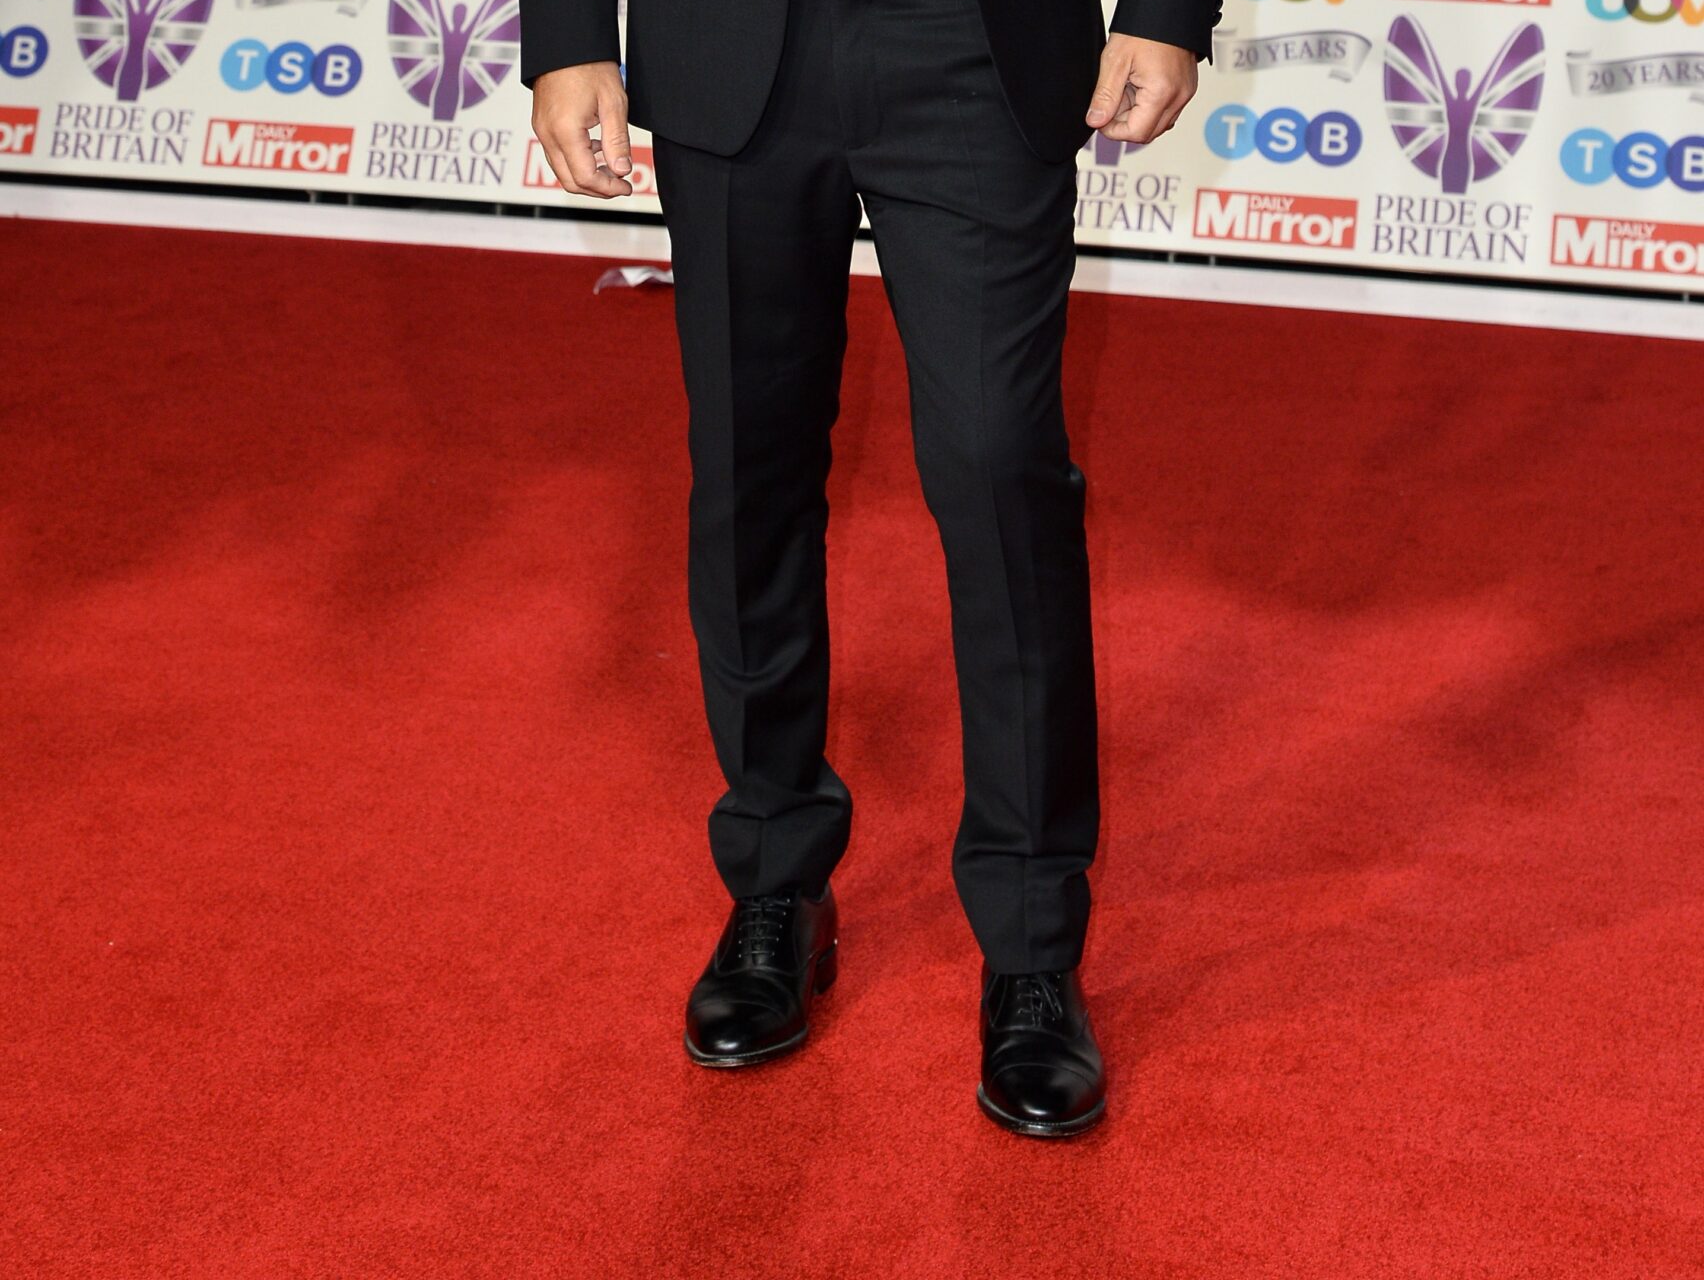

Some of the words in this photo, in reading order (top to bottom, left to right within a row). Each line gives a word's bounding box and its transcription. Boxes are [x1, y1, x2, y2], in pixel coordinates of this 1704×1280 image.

[236, 49, 353, 88] TSB
[1232, 47, 1260, 69] 20
[1265, 39, 1347, 63] YEARS
[1587, 70, 1616, 92] 20
[54, 102, 144, 131] PRIDE
[150, 107, 195, 136] OF
[255, 124, 298, 140] DAILY
[1220, 115, 1350, 157] TSB
[49, 130, 189, 165] BRITAIN
[204, 121, 349, 172] Mirror
[369, 121, 463, 154] PRIDE
[468, 127, 514, 156] OF
[365, 151, 508, 187] BRITAIN
[1135, 172, 1182, 202] OF
[1250, 195, 1294, 211] DAILY
[1195, 191, 1355, 247] Mirror
[1373, 192, 1478, 226] PRIDE
[1484, 201, 1533, 232] OF
[1608, 220, 1657, 238] DAILY
[1370, 223, 1530, 265] BRITAIN
